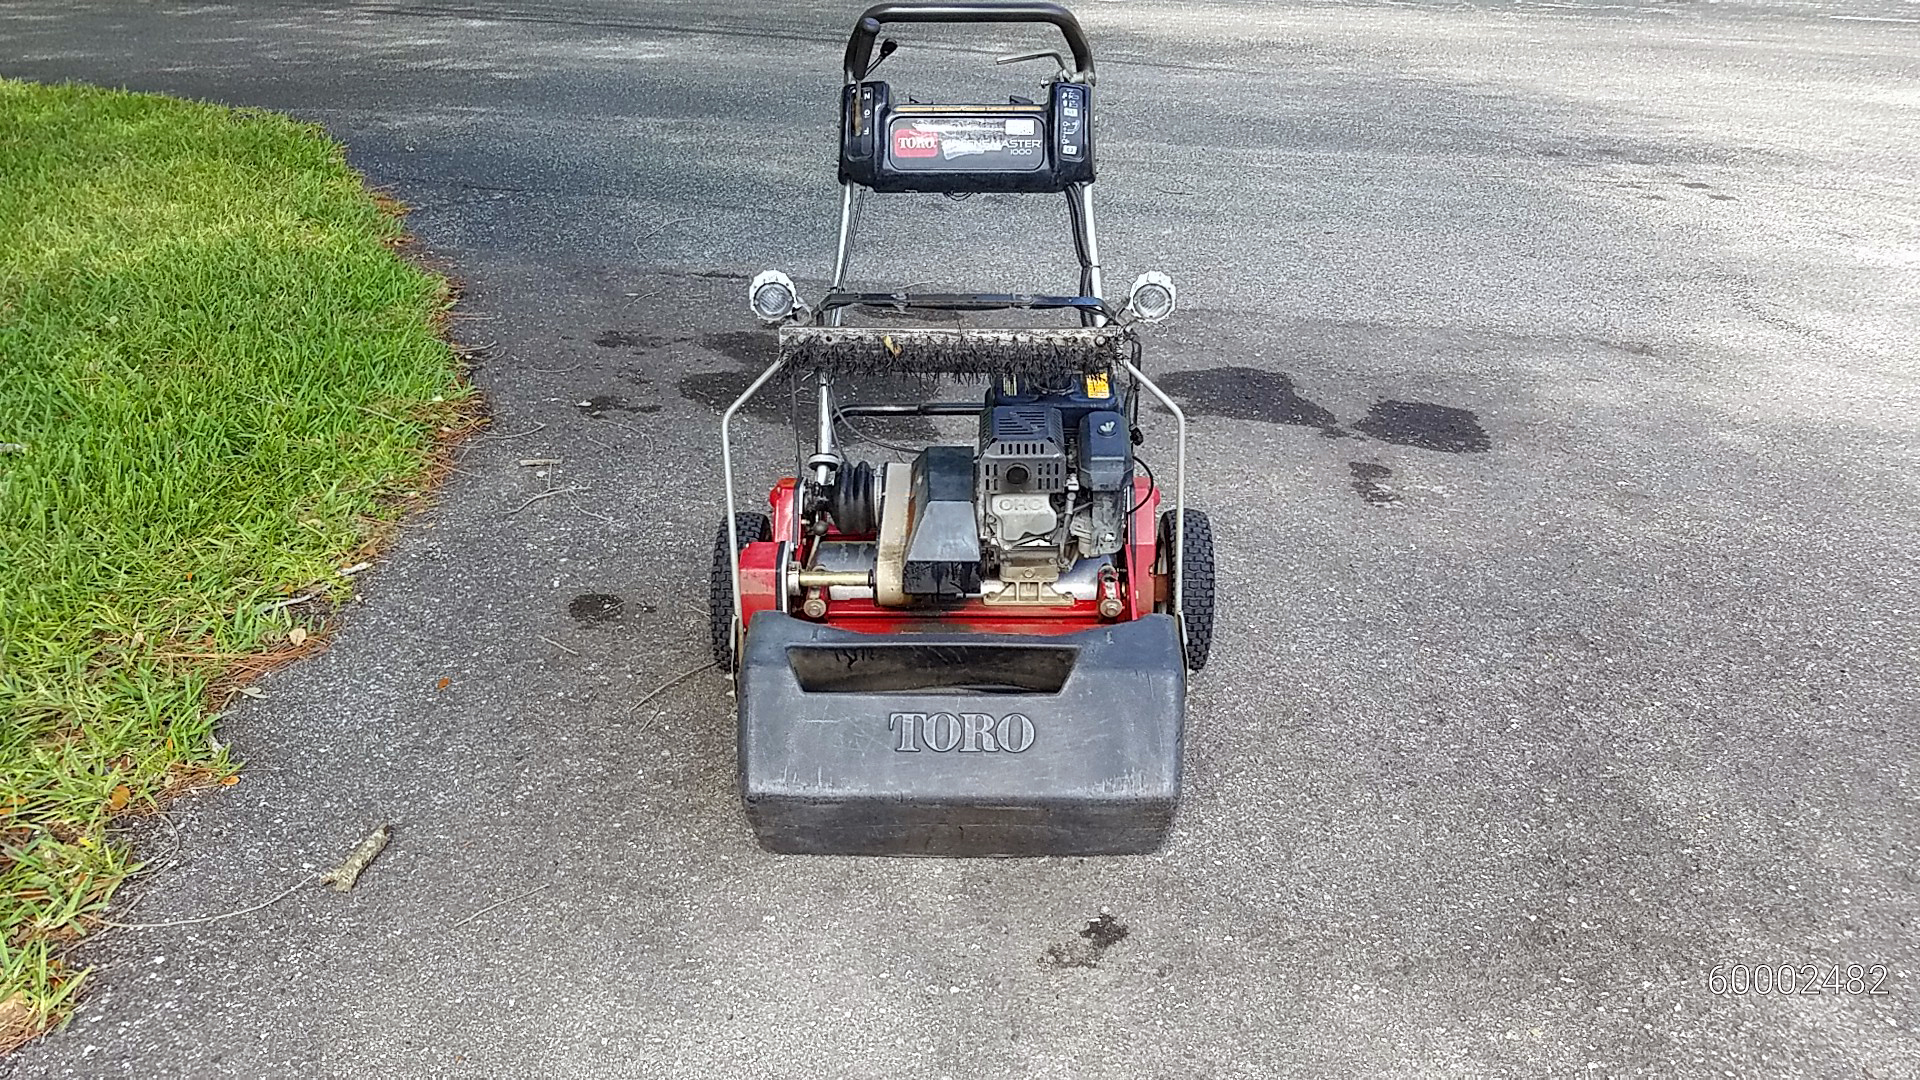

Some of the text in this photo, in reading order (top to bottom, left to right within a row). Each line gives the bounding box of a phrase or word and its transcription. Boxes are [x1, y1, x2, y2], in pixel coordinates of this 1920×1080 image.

[897, 136, 935, 149] TORO
[1010, 148, 1032, 156] 1000
[999, 496, 1043, 511] OHC
[889, 712, 1036, 753] TORO
